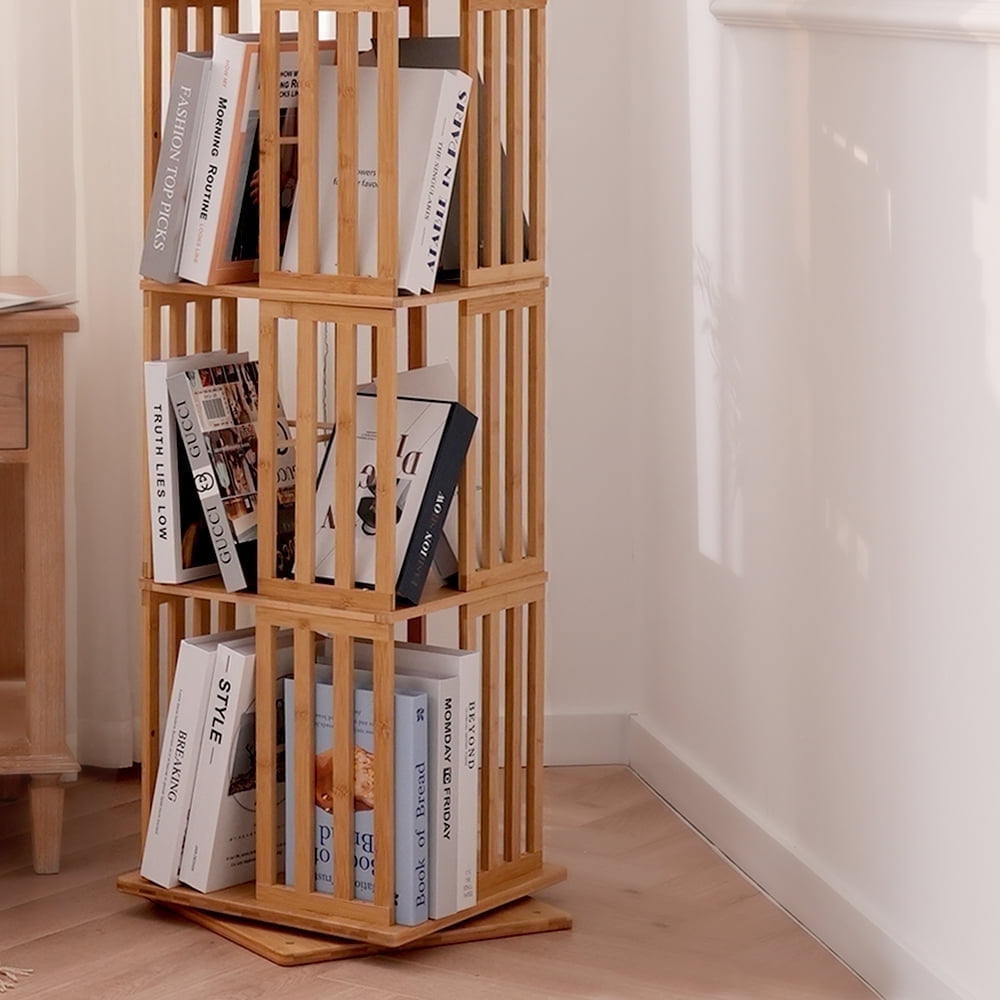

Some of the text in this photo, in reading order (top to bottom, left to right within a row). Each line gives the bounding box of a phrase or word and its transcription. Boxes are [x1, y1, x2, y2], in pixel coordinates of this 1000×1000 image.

[211, 97, 227, 157] MORNING
[447, 90, 467, 158] PARIS
[153, 85, 192, 251] FASHION TOP PICKS
[200, 165, 217, 220] ROUTINE
[176, 400, 201, 458] GUCCI
[154, 404, 167, 540] TRUTH LIES LOW
[206, 506, 232, 565] GUCCI
[209, 678, 232, 745] STYLE
[468, 701, 476, 769] BEYOND
[167, 730, 187, 802] BREAKING
[415, 762, 426, 907] Book of Bread
[443, 788, 451, 840] FRIDAY
